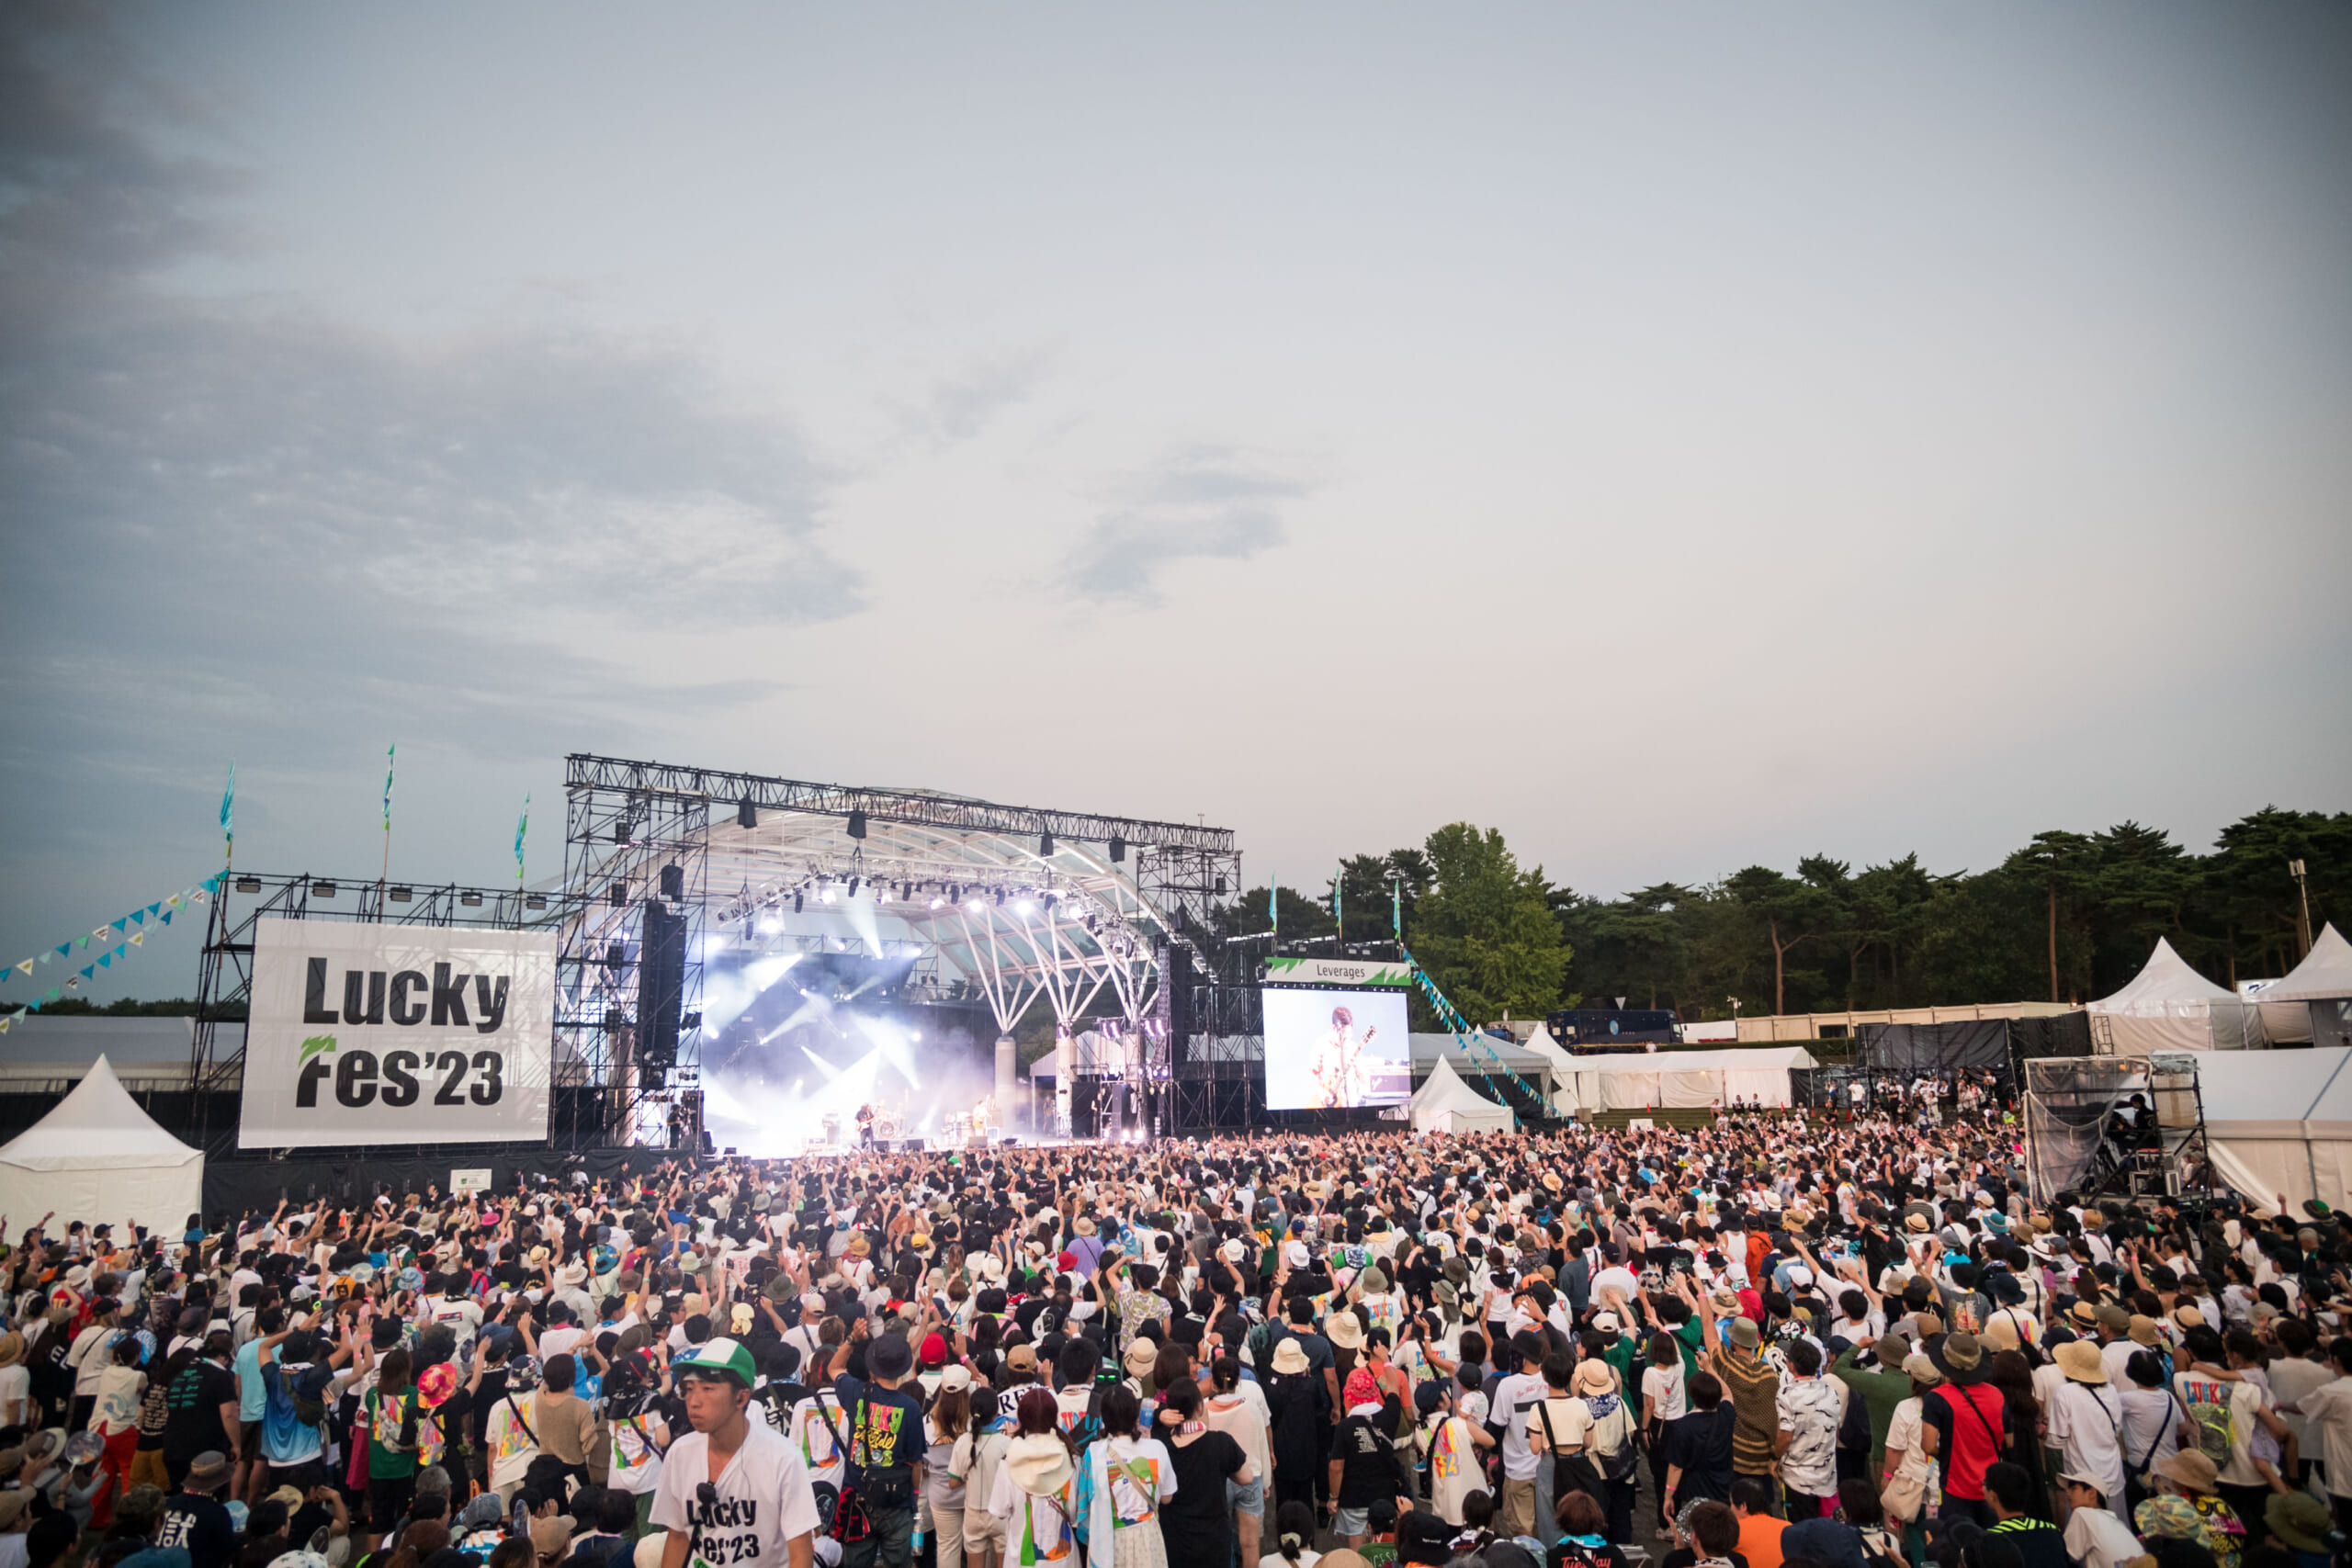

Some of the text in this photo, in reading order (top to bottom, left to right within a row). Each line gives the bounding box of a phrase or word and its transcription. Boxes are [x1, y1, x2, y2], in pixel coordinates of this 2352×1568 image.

[303, 957, 510, 1033] Lucky
[1317, 964, 1365, 979] Leverages
[296, 1034, 503, 1108] Fes'23
